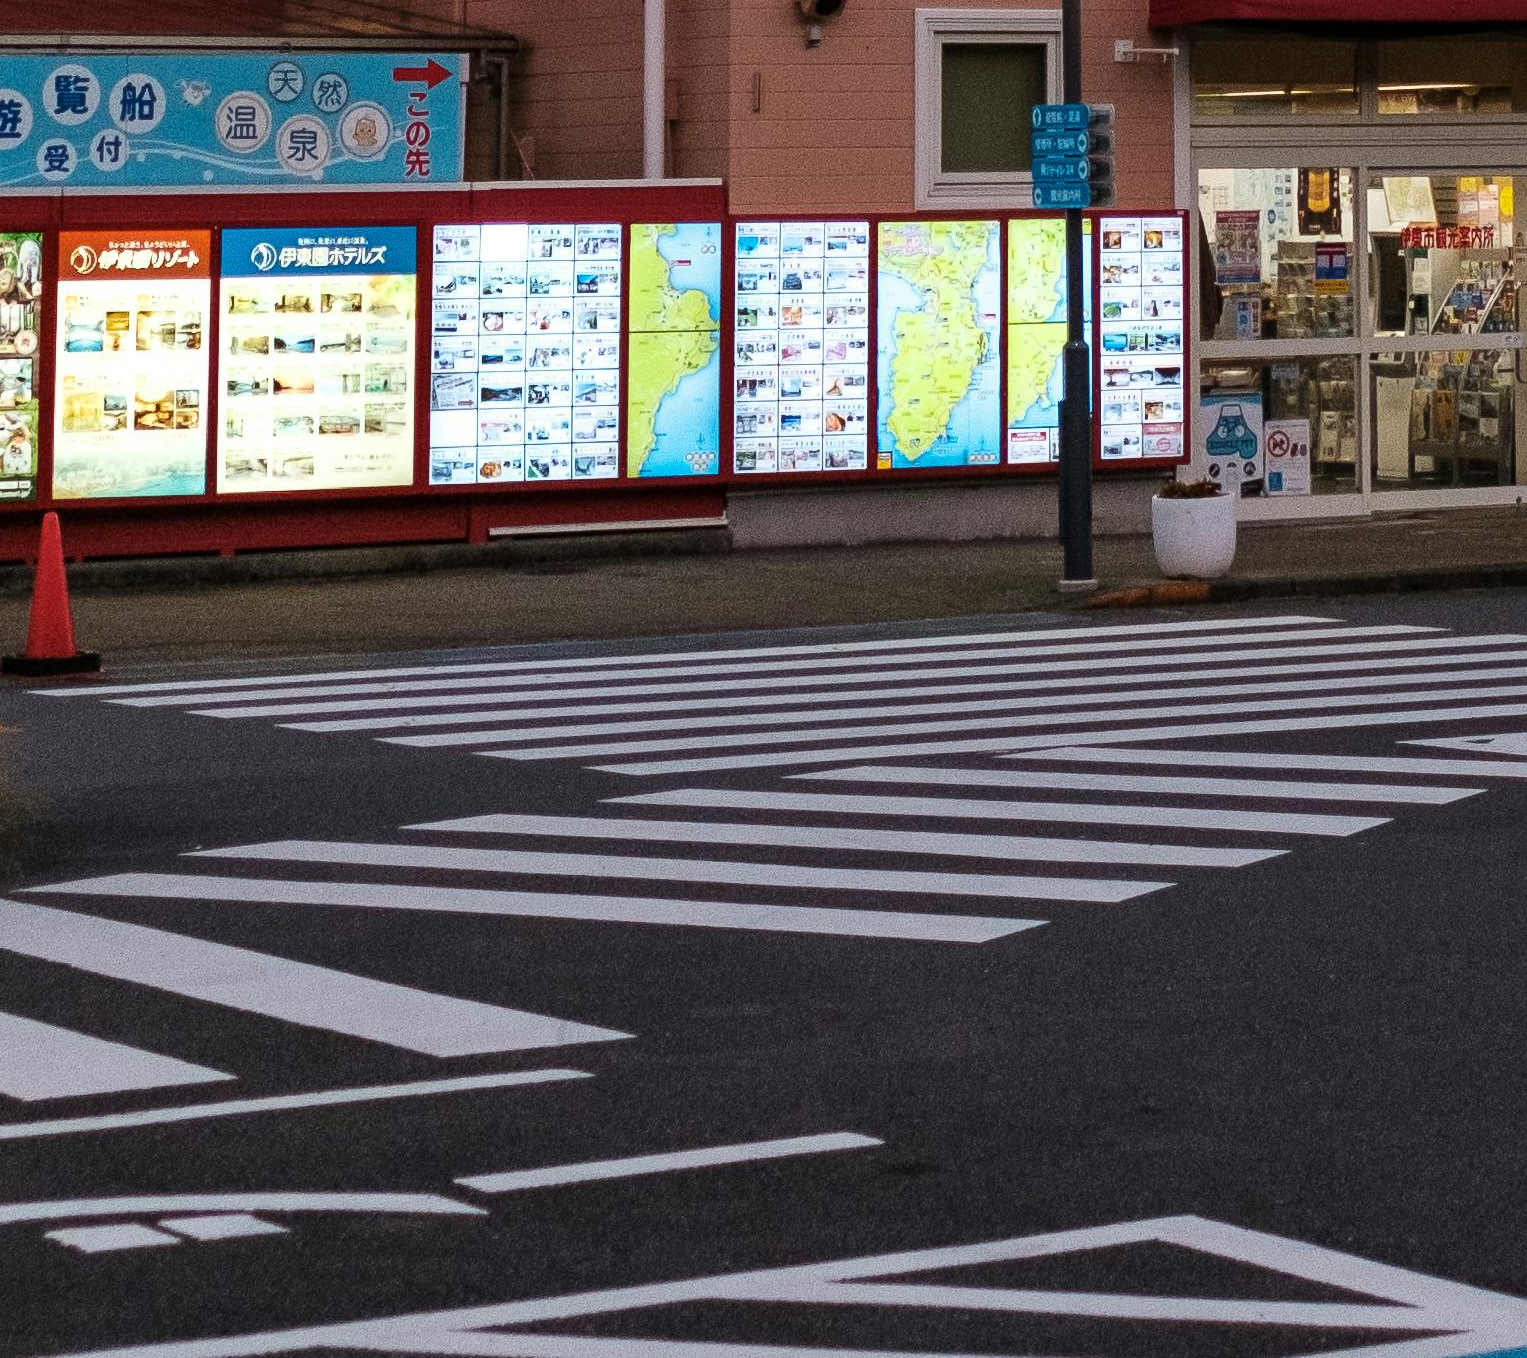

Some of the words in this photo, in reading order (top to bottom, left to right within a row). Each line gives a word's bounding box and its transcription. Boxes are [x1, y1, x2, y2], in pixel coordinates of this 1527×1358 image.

[403, 90, 432, 178] この先
[278, 245, 387, 268] 伊東園ホテルズ
